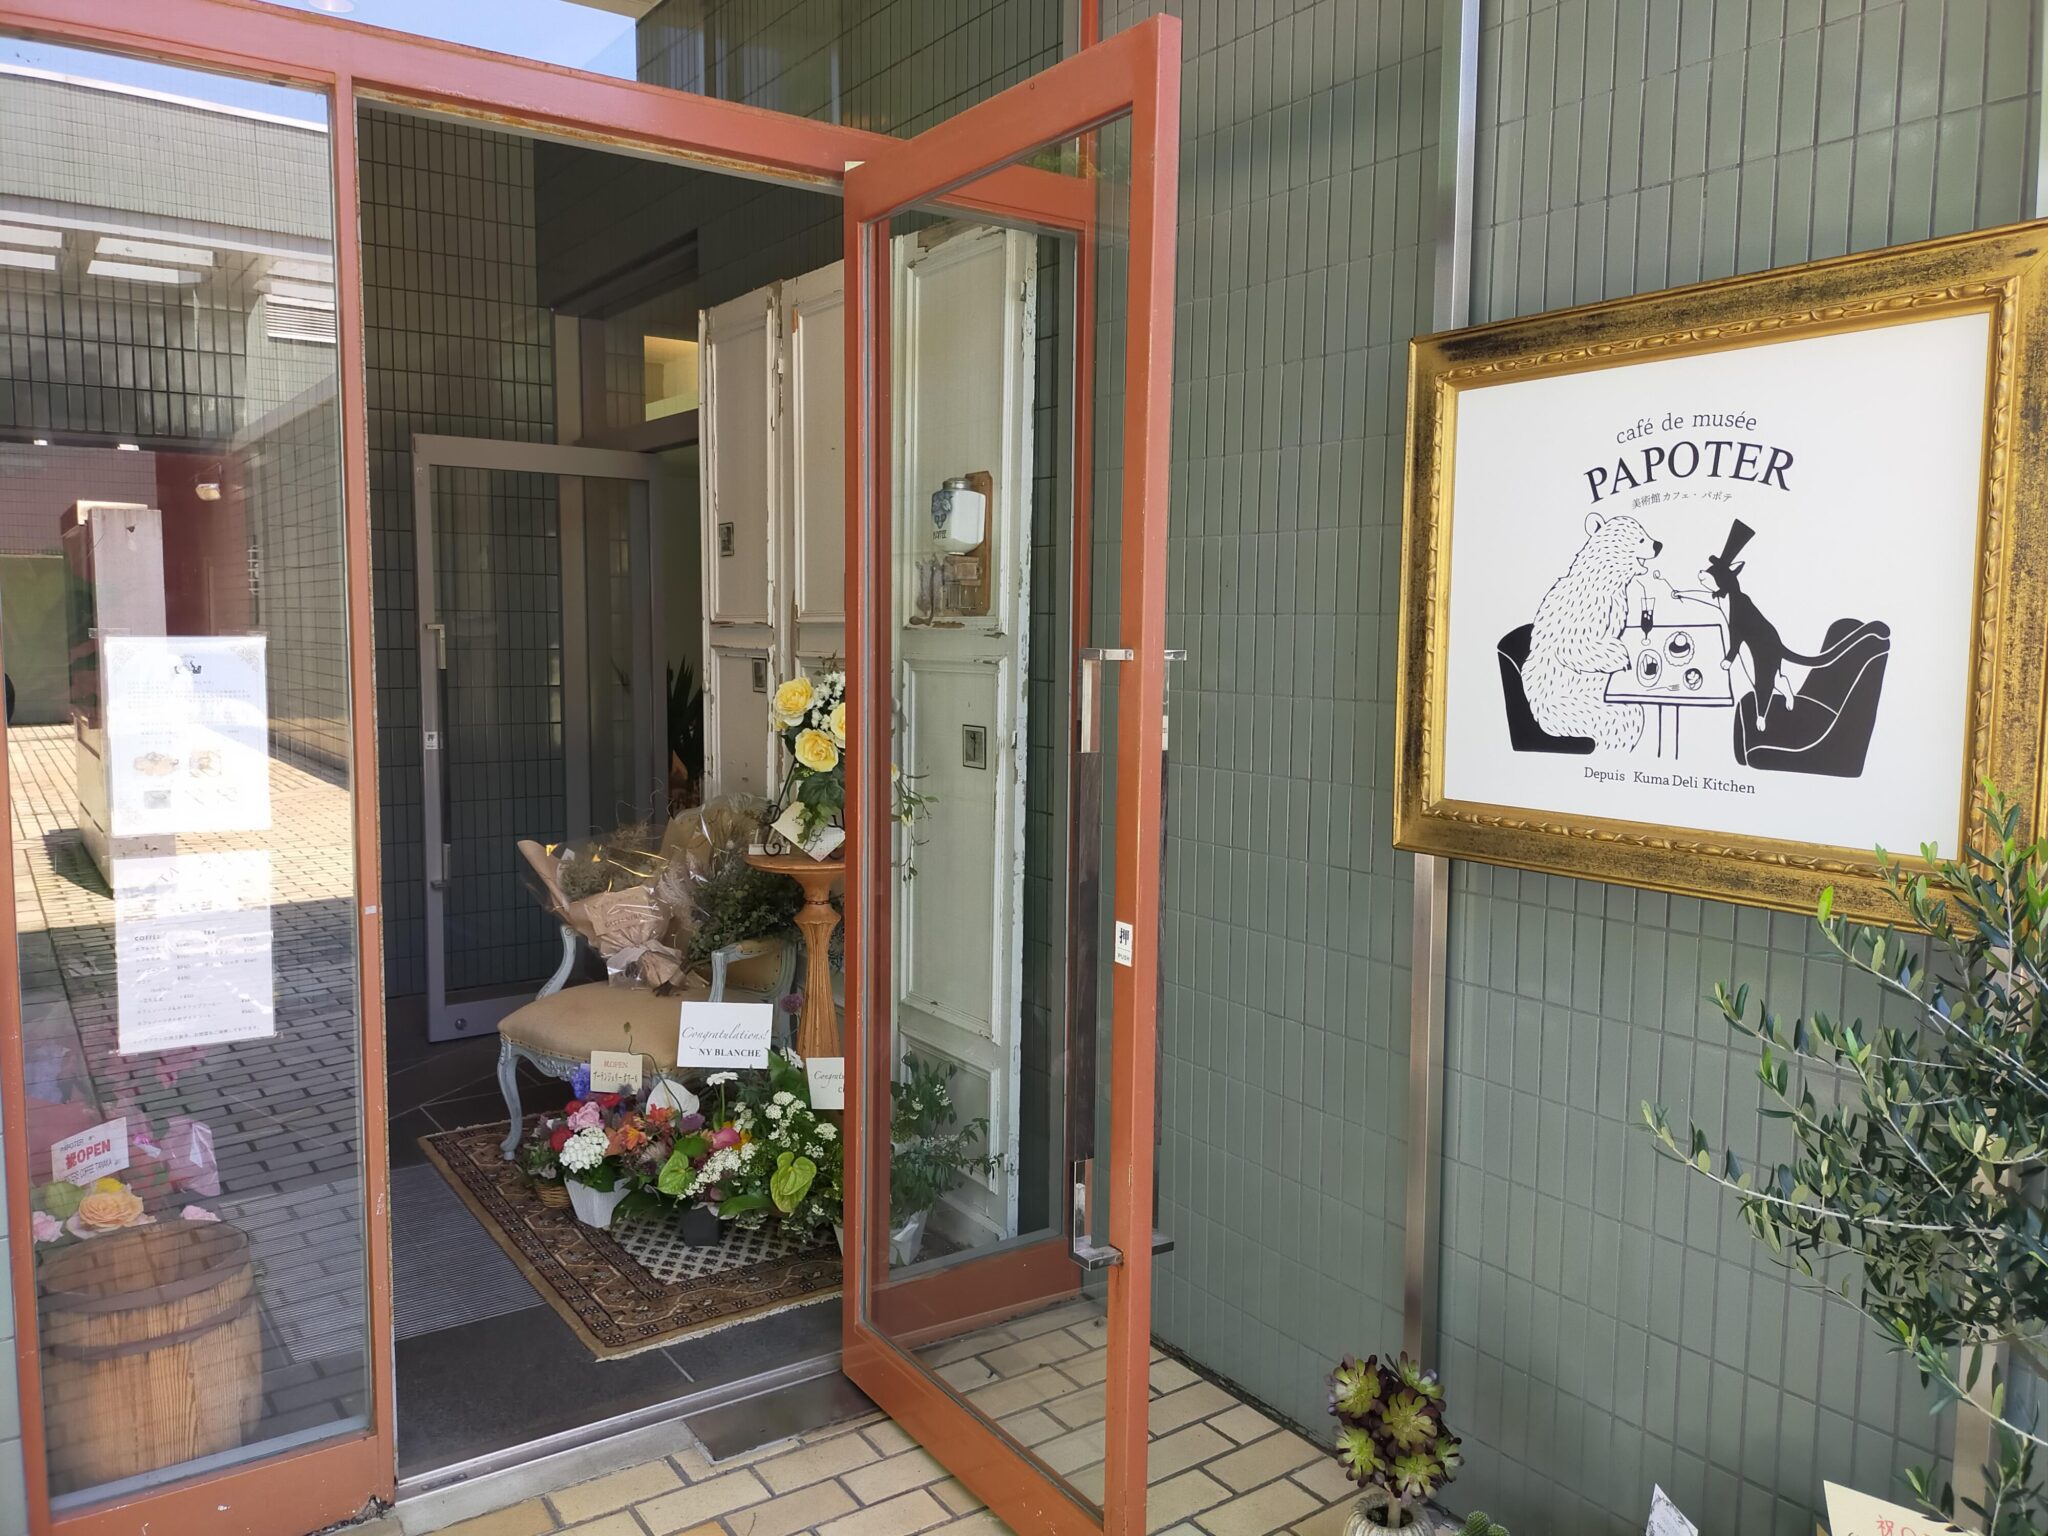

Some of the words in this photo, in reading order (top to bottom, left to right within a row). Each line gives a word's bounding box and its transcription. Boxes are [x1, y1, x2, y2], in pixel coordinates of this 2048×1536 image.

[1616, 417, 1654, 444] café
[1661, 412, 1684, 431] de
[1692, 410, 1757, 431] musée
[1583, 440, 1794, 504] PAPOTER
[1584, 766, 1625, 783] Depuis
[1633, 771, 1670, 786] Kuma
[1672, 774, 1698, 789] Deli
[1702, 777, 1756, 794] Kitchen
[1119, 927, 1130, 945] 押
[681, 1023, 770, 1050] Congratulations!
[698, 1048, 713, 1056] NY
[714, 1048, 762, 1058] BLANCHE
